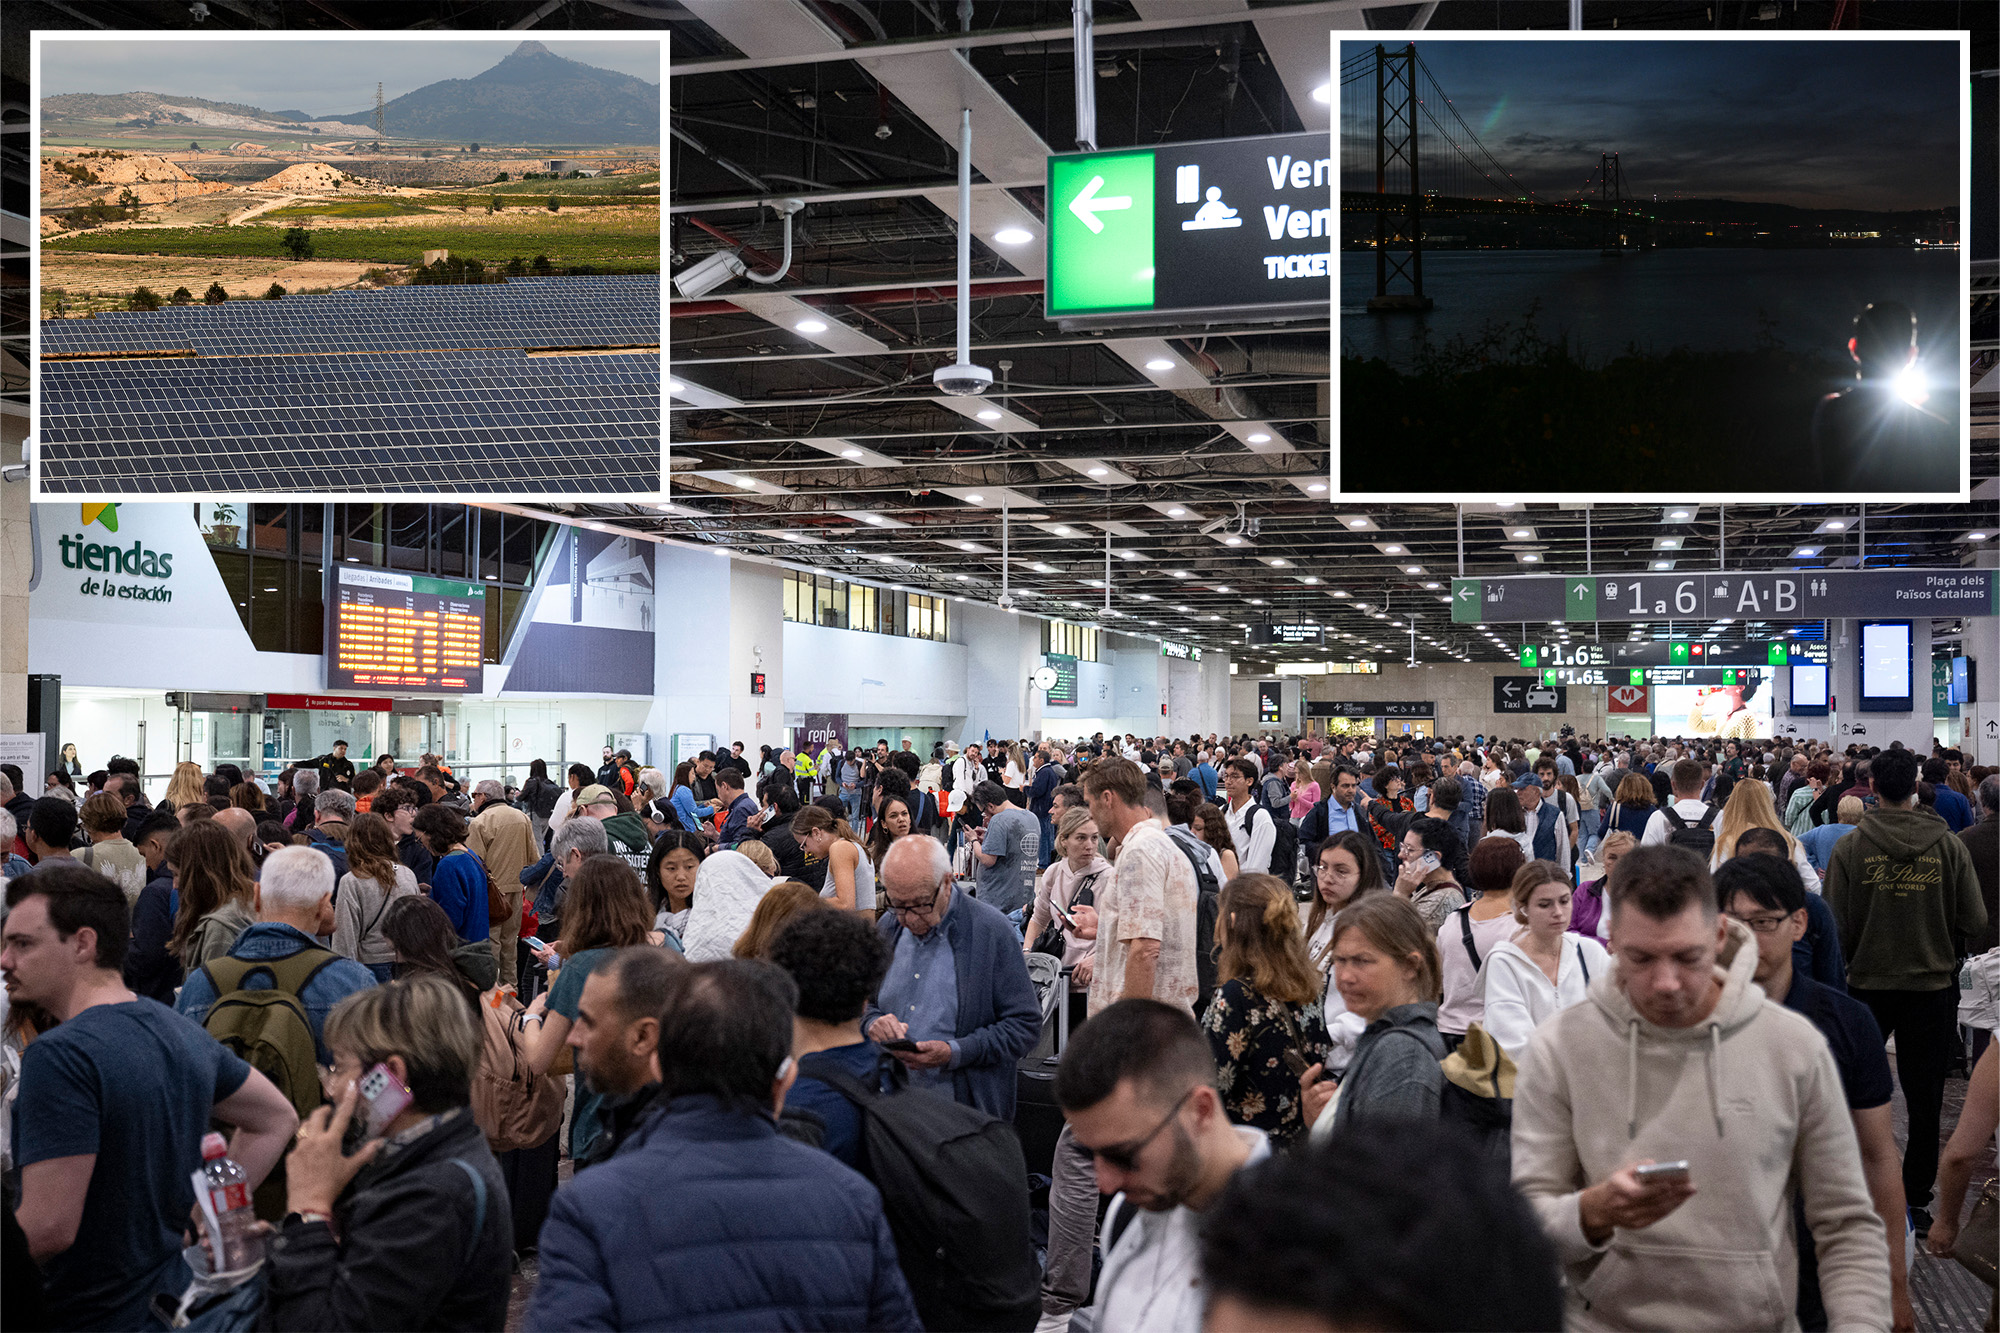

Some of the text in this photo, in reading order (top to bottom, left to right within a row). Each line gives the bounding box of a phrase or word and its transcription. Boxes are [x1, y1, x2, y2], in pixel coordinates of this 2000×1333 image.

[58, 533, 173, 579] tiendas
[369, 575, 393, 585] Arribades
[1926, 576, 1985, 588] Plaça dels
[80, 577, 173, 603] de la estación
[1896, 588, 1985, 600] Països Catalans
[1628, 581, 1697, 614] 1 a 6
[1552, 645, 1565, 666] 1
[1575, 645, 1589, 666] 6
[1582, 670, 1593, 685] 6
[1620, 688, 1635, 701] M
[1385, 705, 1398, 713] WC
[1503, 700, 1521, 709] Taxi
[808, 721, 836, 745] renfe
[1861, 864, 1942, 885] Le Studio
[1878, 883, 1926, 891] ONE WORLD
